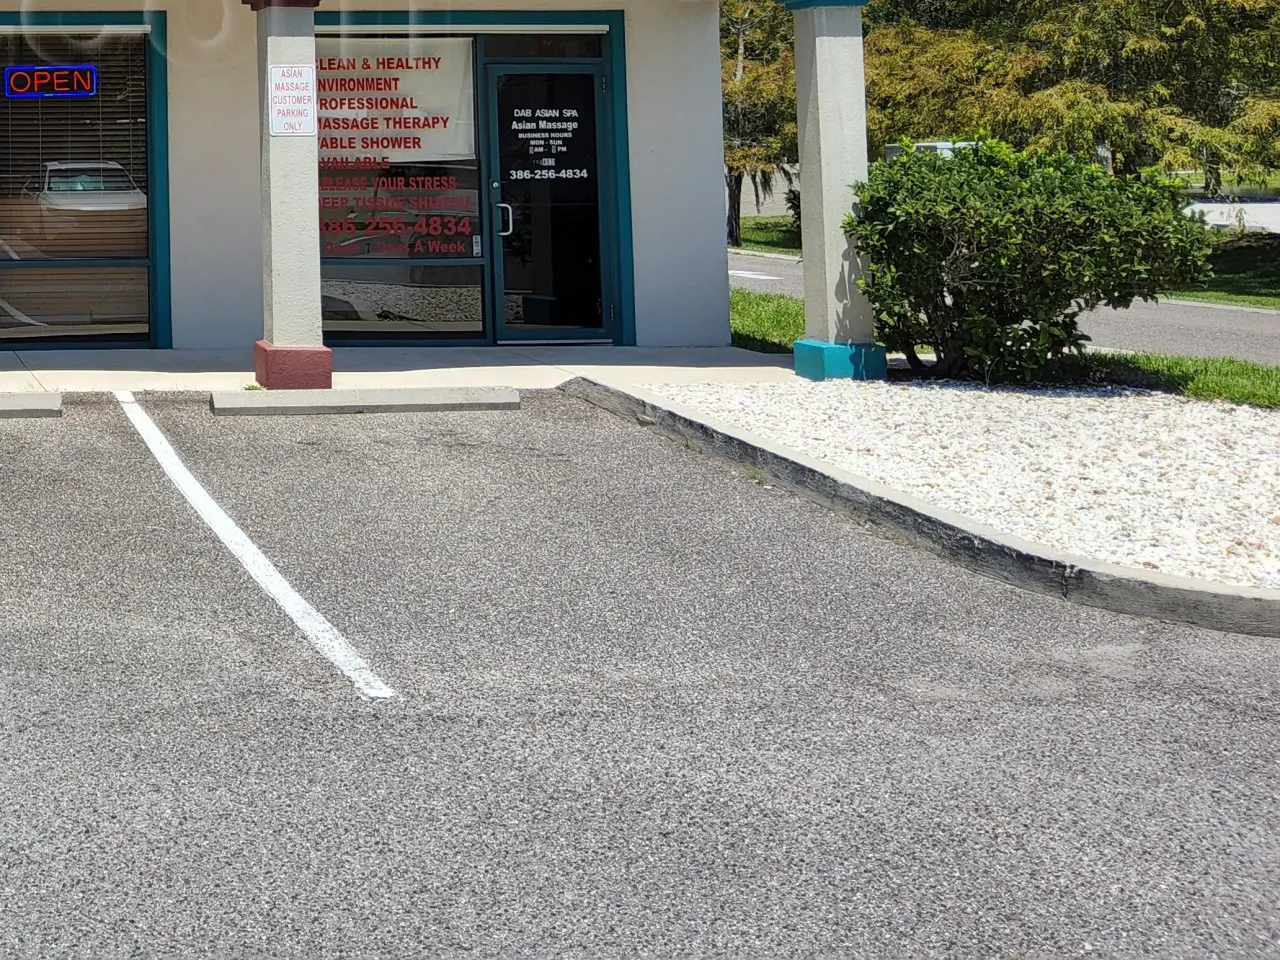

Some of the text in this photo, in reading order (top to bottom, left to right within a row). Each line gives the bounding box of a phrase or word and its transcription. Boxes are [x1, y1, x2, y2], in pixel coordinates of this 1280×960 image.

[362, 58, 371, 70] &
[376, 57, 442, 70] HEALTHY
[281, 69, 302, 78] ASIAN
[10, 71, 91, 92] OPEN
[274, 82, 310, 91] MASSAGE
[317, 77, 400, 91] NVIRONMENT
[273, 96, 312, 104] CUSTOMER
[317, 97, 418, 110] ROFESSIONAL
[277, 109, 308, 118] PARKING
[514, 109, 579, 117] DAB ASIAN SPA
[284, 122, 302, 131] ONLY
[383, 116, 450, 129] THERAPY
[511, 120, 578, 130] Asian Massage
[319, 136, 422, 149] ABLE SHOWER
[320, 157, 390, 169] VAILABLE
[510, 169, 588, 179] 386-256-4834
[373, 176, 405, 191] YOUR
[409, 176, 458, 190] STRESS
[322, 196, 349, 209] EEP
[353, 196, 404, 209] TISSUE
[414, 240, 424, 253] A
[428, 240, 466, 253] Week
